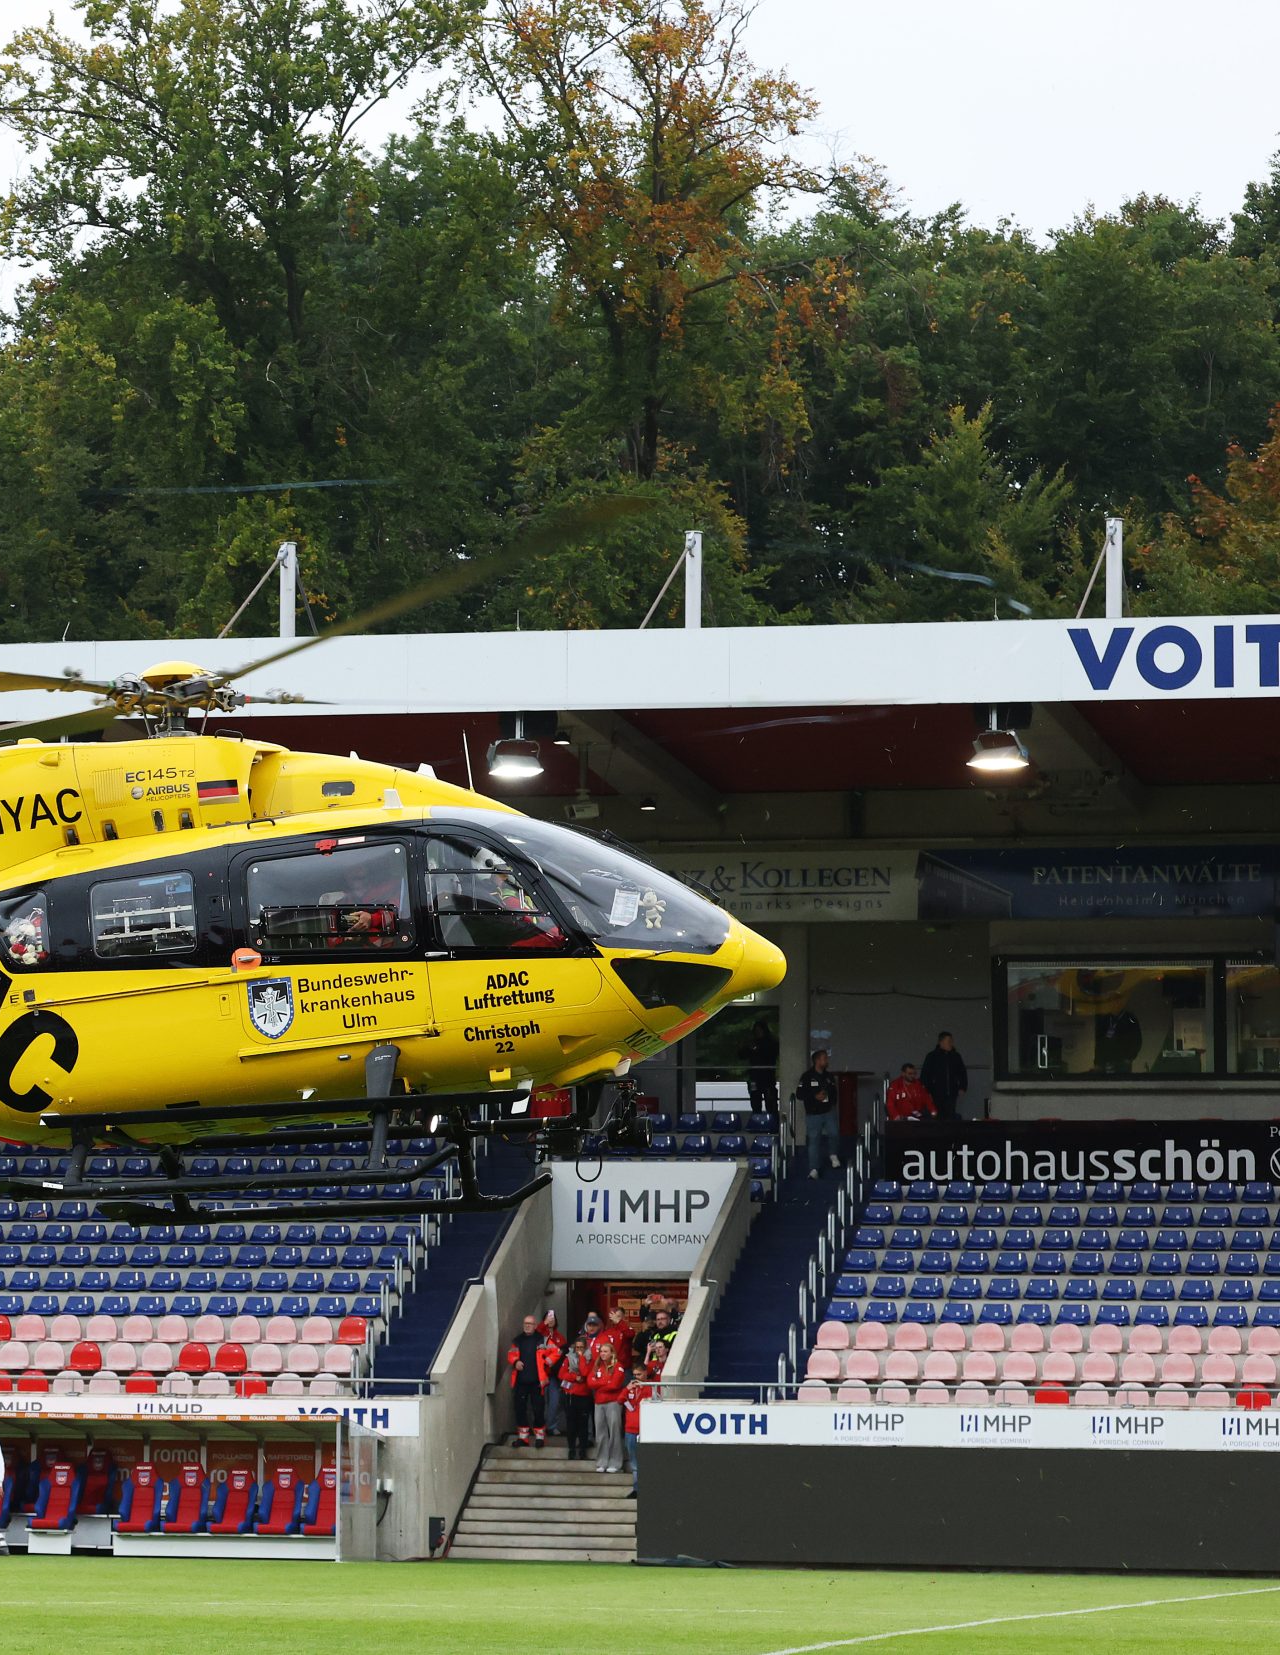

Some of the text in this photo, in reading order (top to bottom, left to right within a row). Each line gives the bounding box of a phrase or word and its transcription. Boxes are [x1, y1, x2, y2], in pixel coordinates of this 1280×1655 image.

[1067, 624, 1280, 691] VOIT
[146, 783, 190, 796] AIRBUS
[146, 793, 191, 802] HELICOPTERS
[710, 866, 736, 893] &
[1031, 859, 1262, 885] PATENTANWÄLTE
[298, 968, 414, 994] Bundeswehr-
[486, 971, 529, 990] ADAC
[300, 988, 416, 1014] krankenhaus
[463, 986, 555, 1011] Luftrettung
[342, 1011, 377, 1030] Ulm
[463, 1020, 540, 1044] Christoph
[495, 1040, 515, 1054] 22
[902, 1139, 1256, 1181] autohausschön
[619, 1189, 710, 1223] MHP
[575, 1233, 710, 1245] A PORSCHE COMPANY
[673, 1412, 768, 1435] VOITH
[856, 1413, 904, 1431] MHP
[983, 1414, 1031, 1432] MHP
[1116, 1416, 1164, 1434] MHP
[154, 1449, 199, 1463] roma
